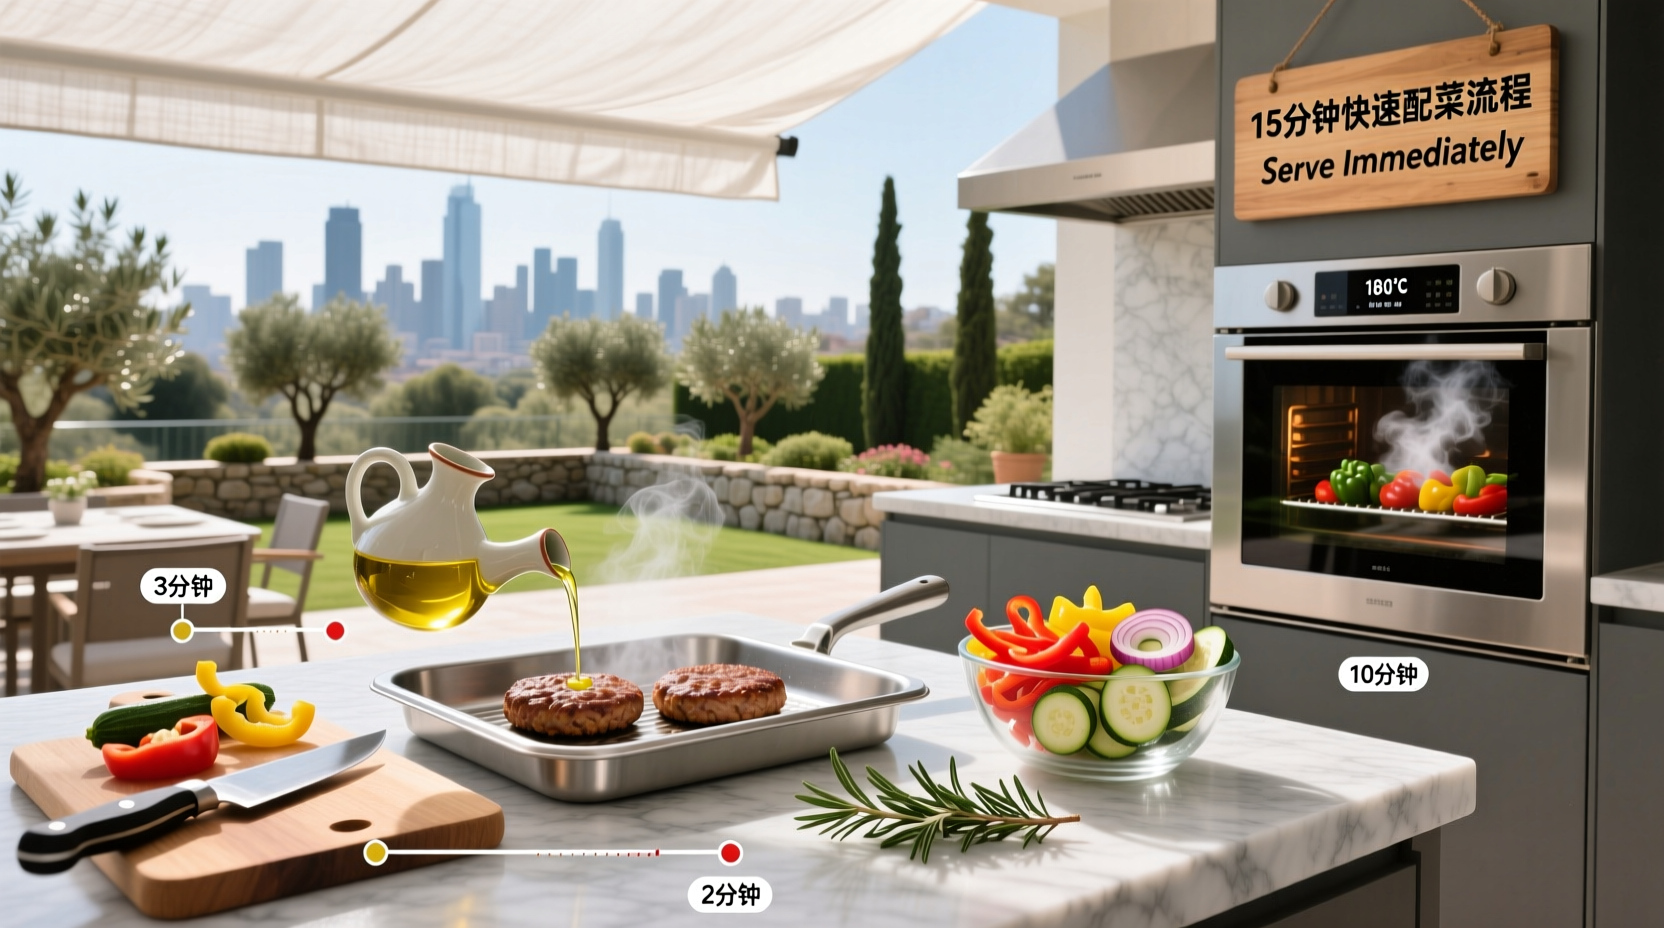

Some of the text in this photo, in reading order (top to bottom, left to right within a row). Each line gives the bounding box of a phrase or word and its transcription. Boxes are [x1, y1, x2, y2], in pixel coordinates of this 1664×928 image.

[1251, 72, 1532, 139] 15分钟快速配菜流程
[1261, 129, 1525, 185] Serve Immediately
